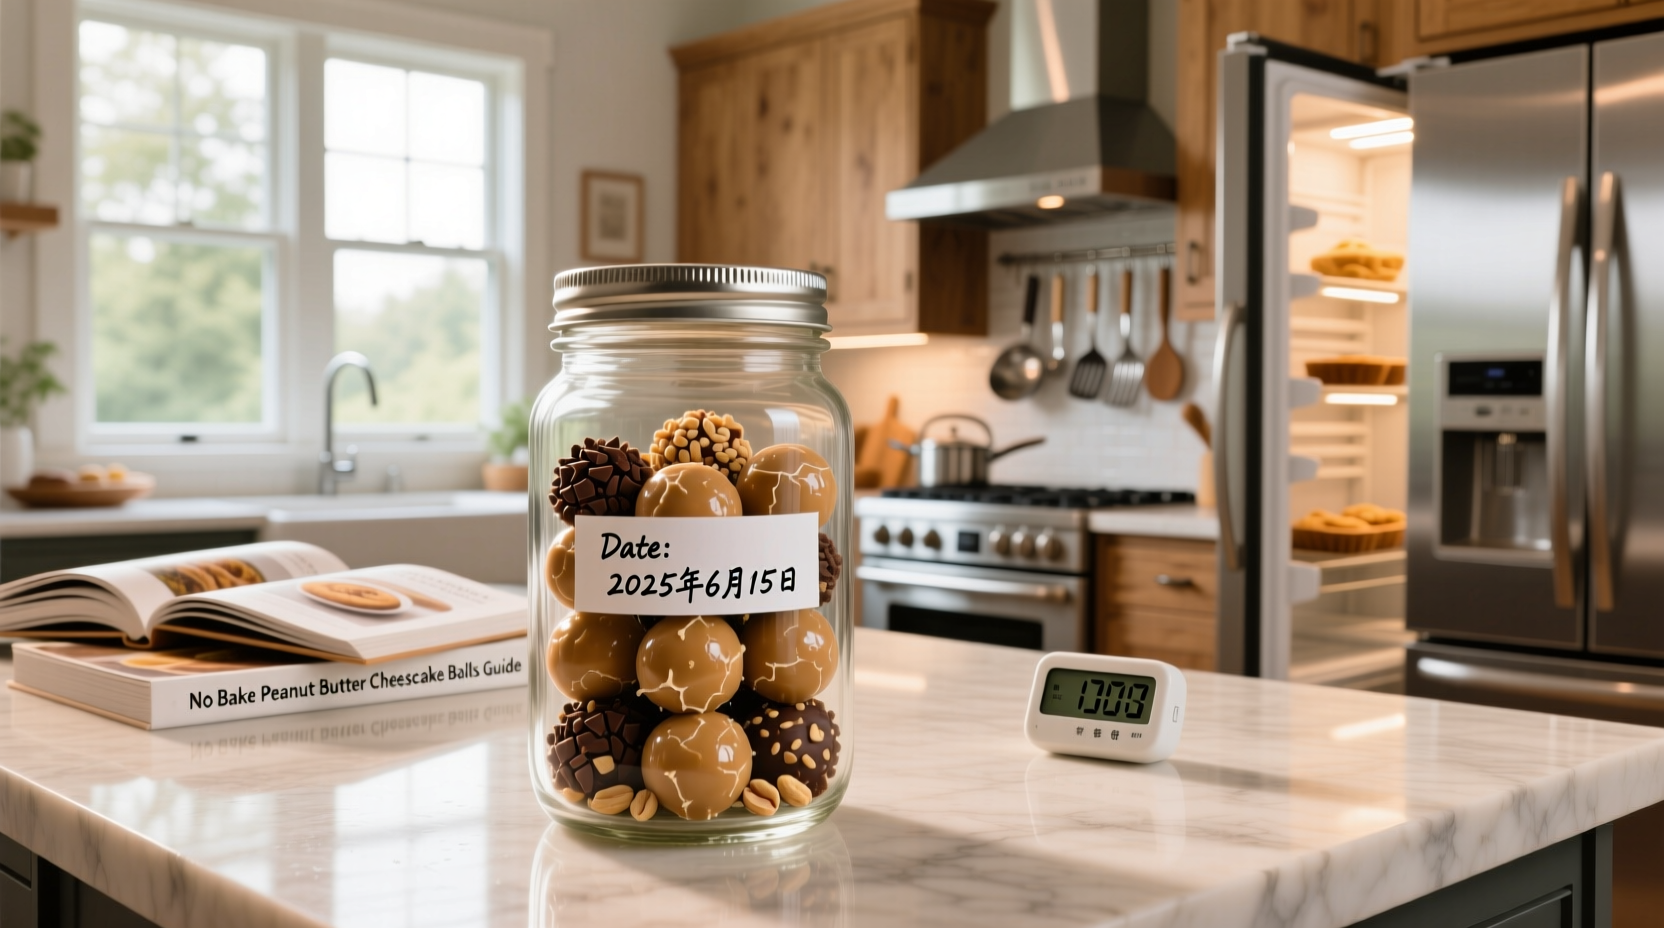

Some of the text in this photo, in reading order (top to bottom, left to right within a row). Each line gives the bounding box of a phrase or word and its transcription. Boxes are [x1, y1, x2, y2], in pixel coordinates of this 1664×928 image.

[601, 532, 670, 560] Date:
[607, 566, 796, 603] 2025年6月15日
[189, 656, 522, 710] No Bake Peanut Butter Cheescake Balls Guide
